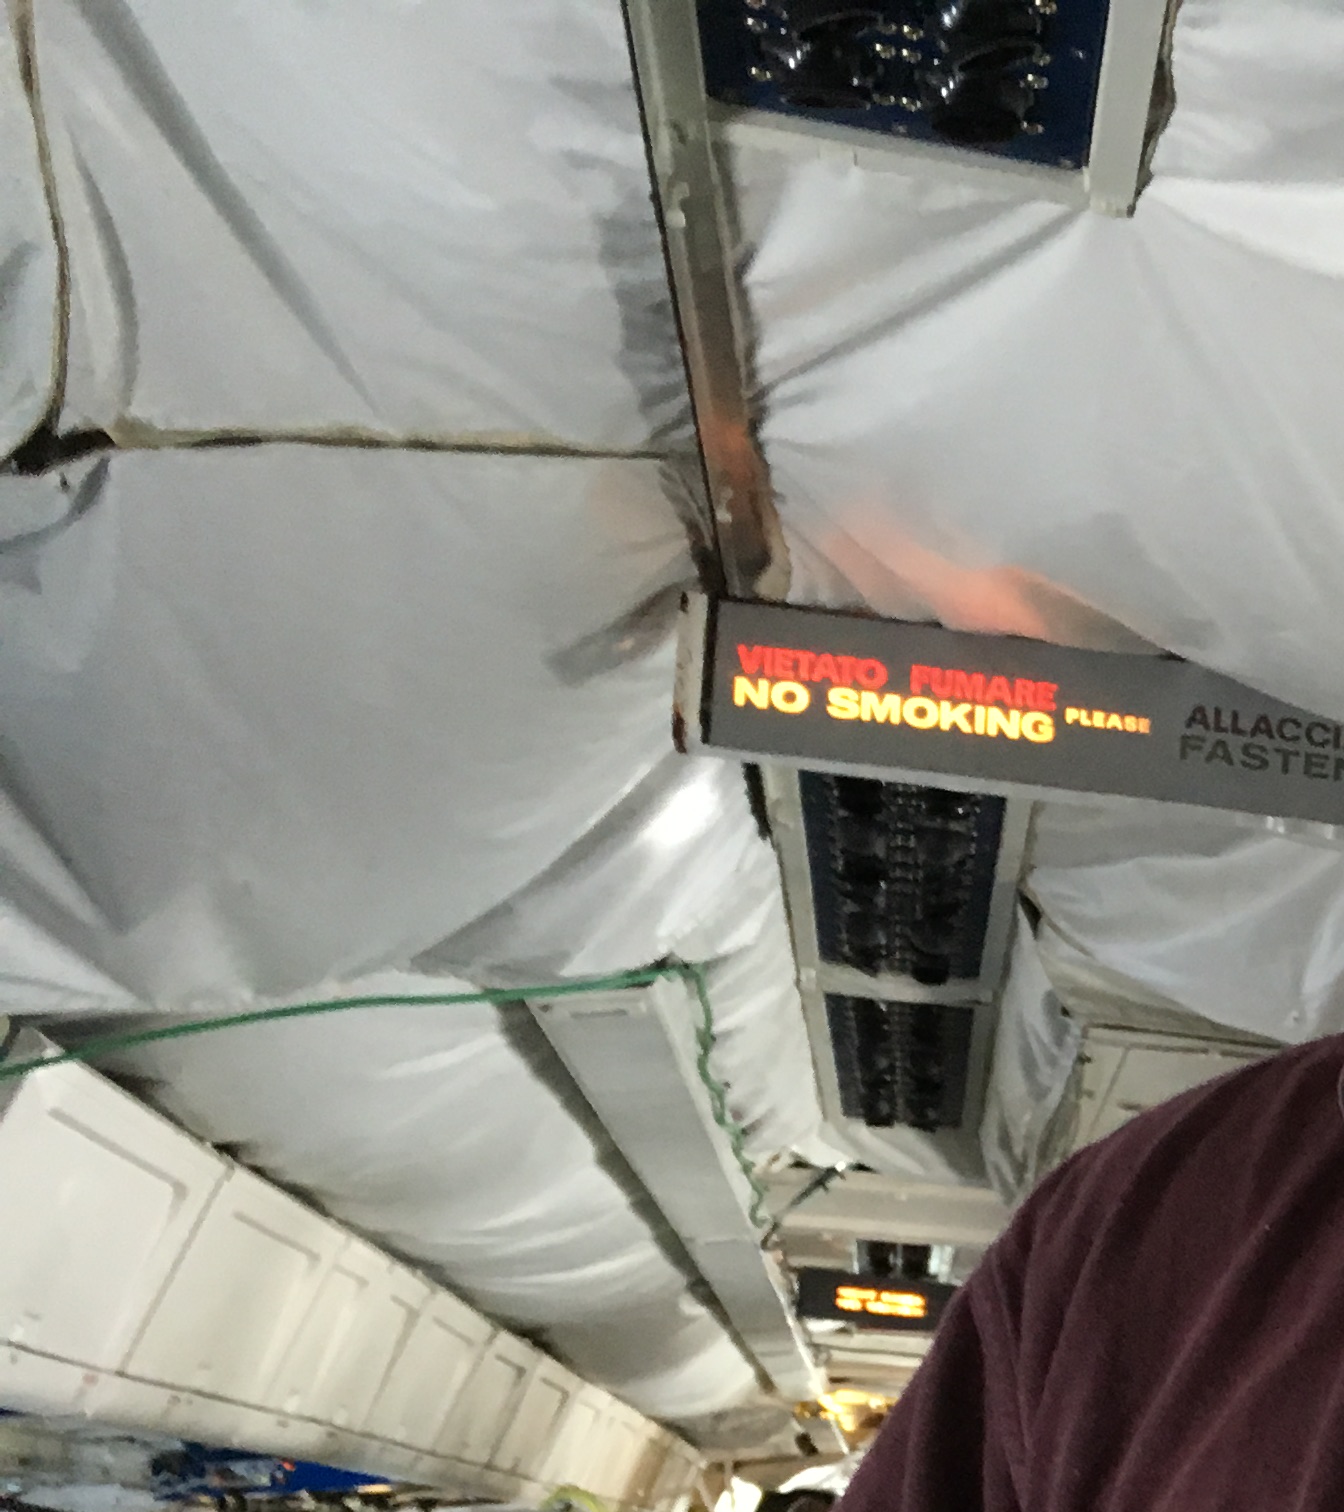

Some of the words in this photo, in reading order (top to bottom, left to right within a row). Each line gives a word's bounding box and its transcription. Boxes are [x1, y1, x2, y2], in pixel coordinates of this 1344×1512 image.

[733, 676, 811, 714] NO
[826, 686, 1056, 744] SMOKING
[1064, 706, 1151, 735] PLEASE
[736, 643, 888, 690] VIETATO
[909, 664, 1059, 712] FUMARE
